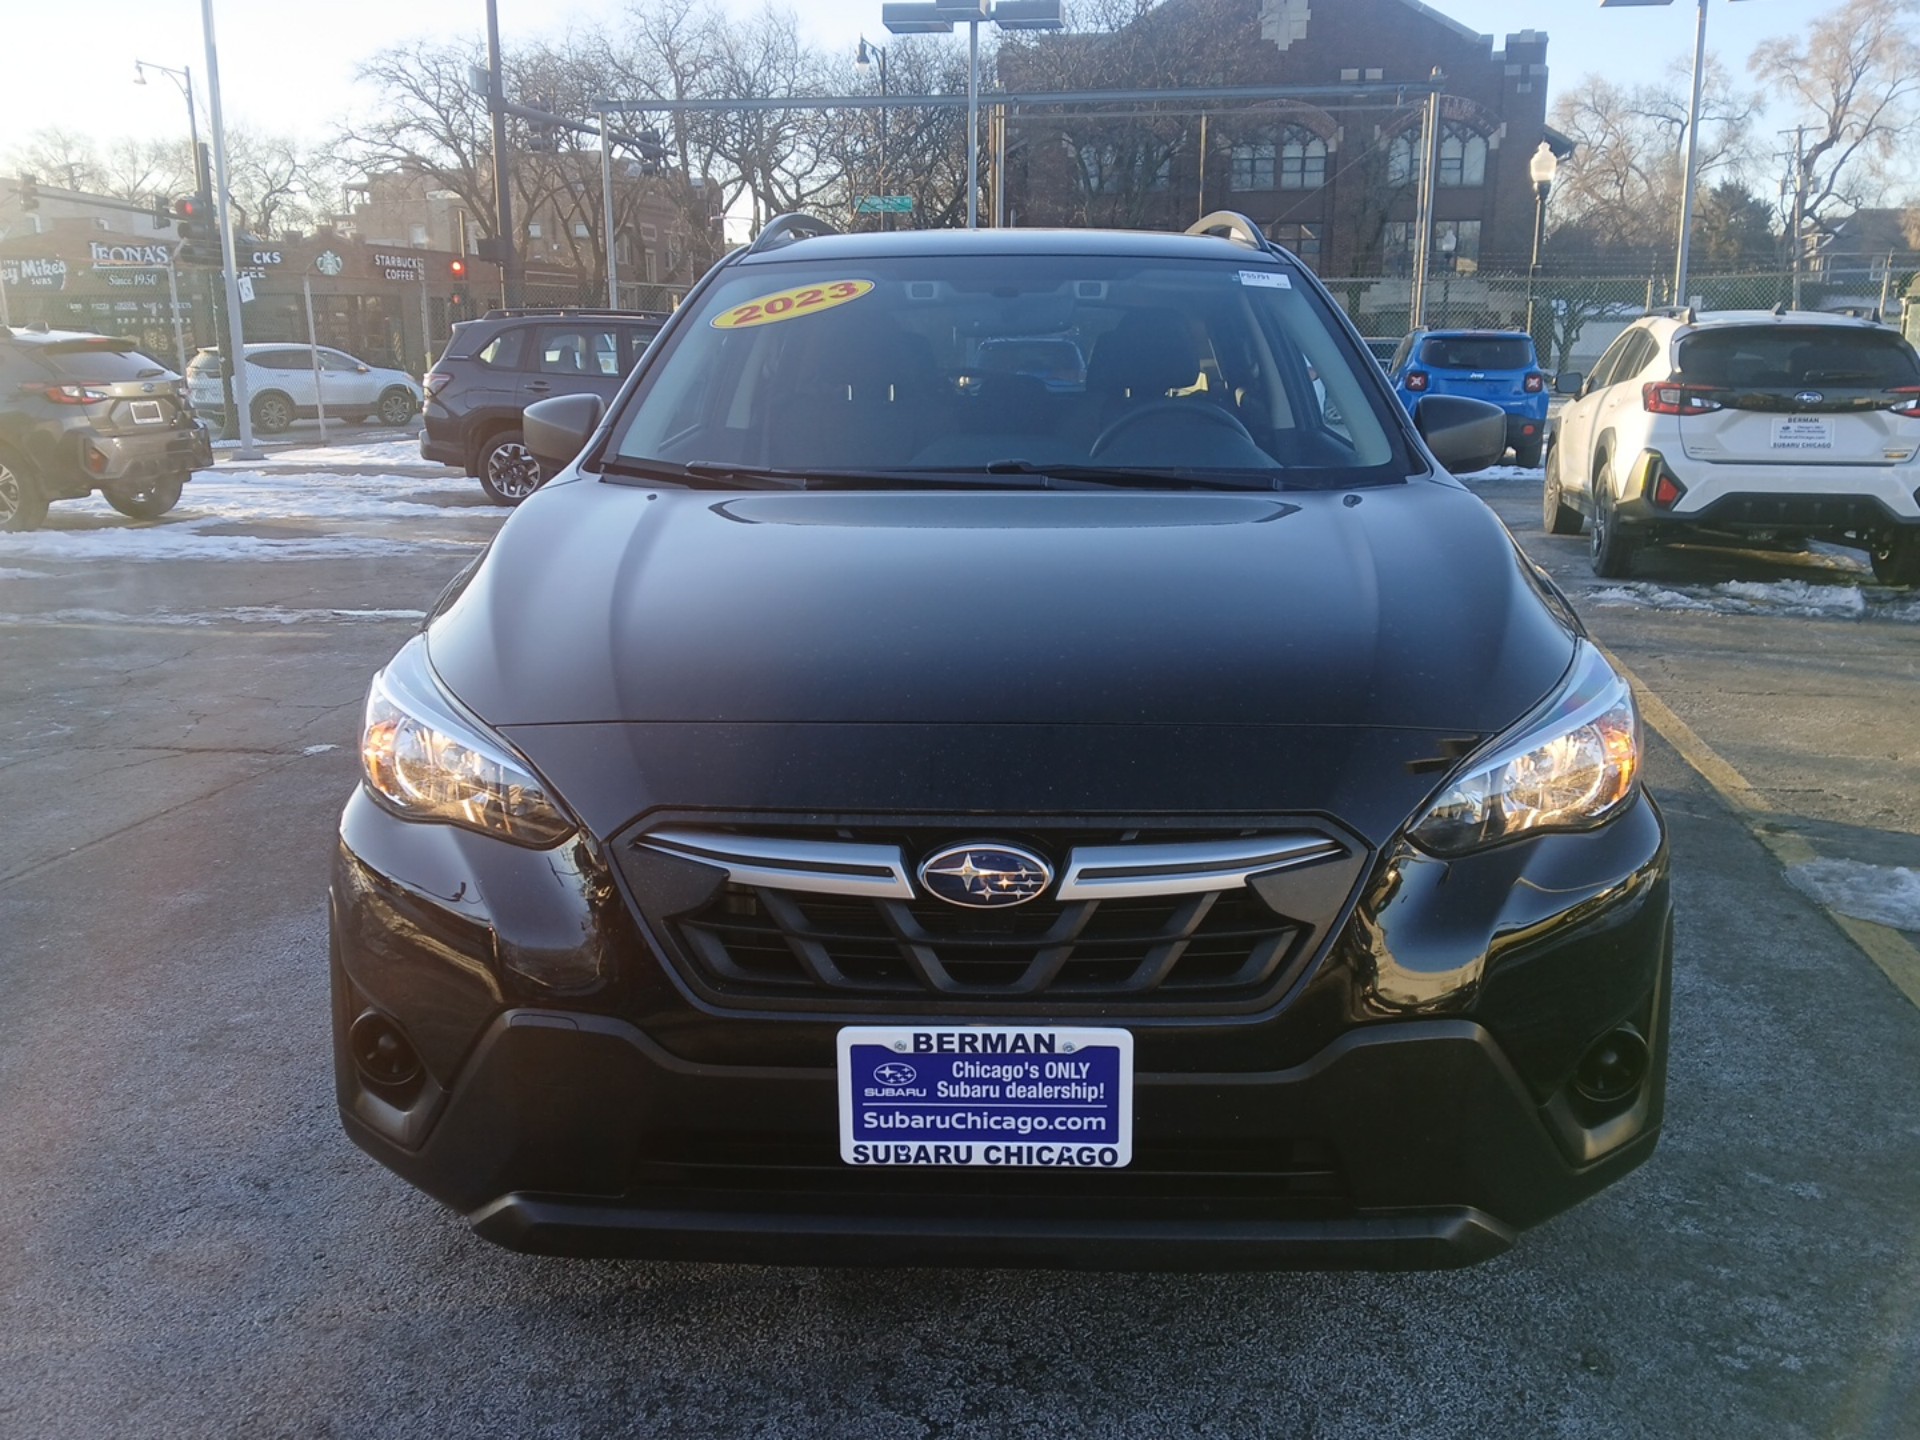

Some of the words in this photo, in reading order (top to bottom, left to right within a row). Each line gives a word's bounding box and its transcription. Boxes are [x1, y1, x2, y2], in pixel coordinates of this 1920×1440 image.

[89, 242, 169, 266] LEONA'S
[375, 254, 418, 269] STARBUCK
[108, 275, 132, 285] Since
[134, 274, 157, 286] 1950
[385, 269, 414, 280] COFFEE
[733, 282, 859, 325] 2023
[912, 1032, 1056, 1054] BERMAN
[951, 1060, 1040, 1082] Chicago's
[1044, 1062, 1091, 1080] ONLY
[864, 1088, 927, 1097] SUBARU
[936, 1081, 1000, 1099] Subaru
[1005, 1082, 1105, 1103] dealership!
[863, 1111, 1106, 1134] SubaruChicago.com
[852, 1144, 973, 1165] SUBARU
[983, 1146, 1119, 1167] CHICAGO
